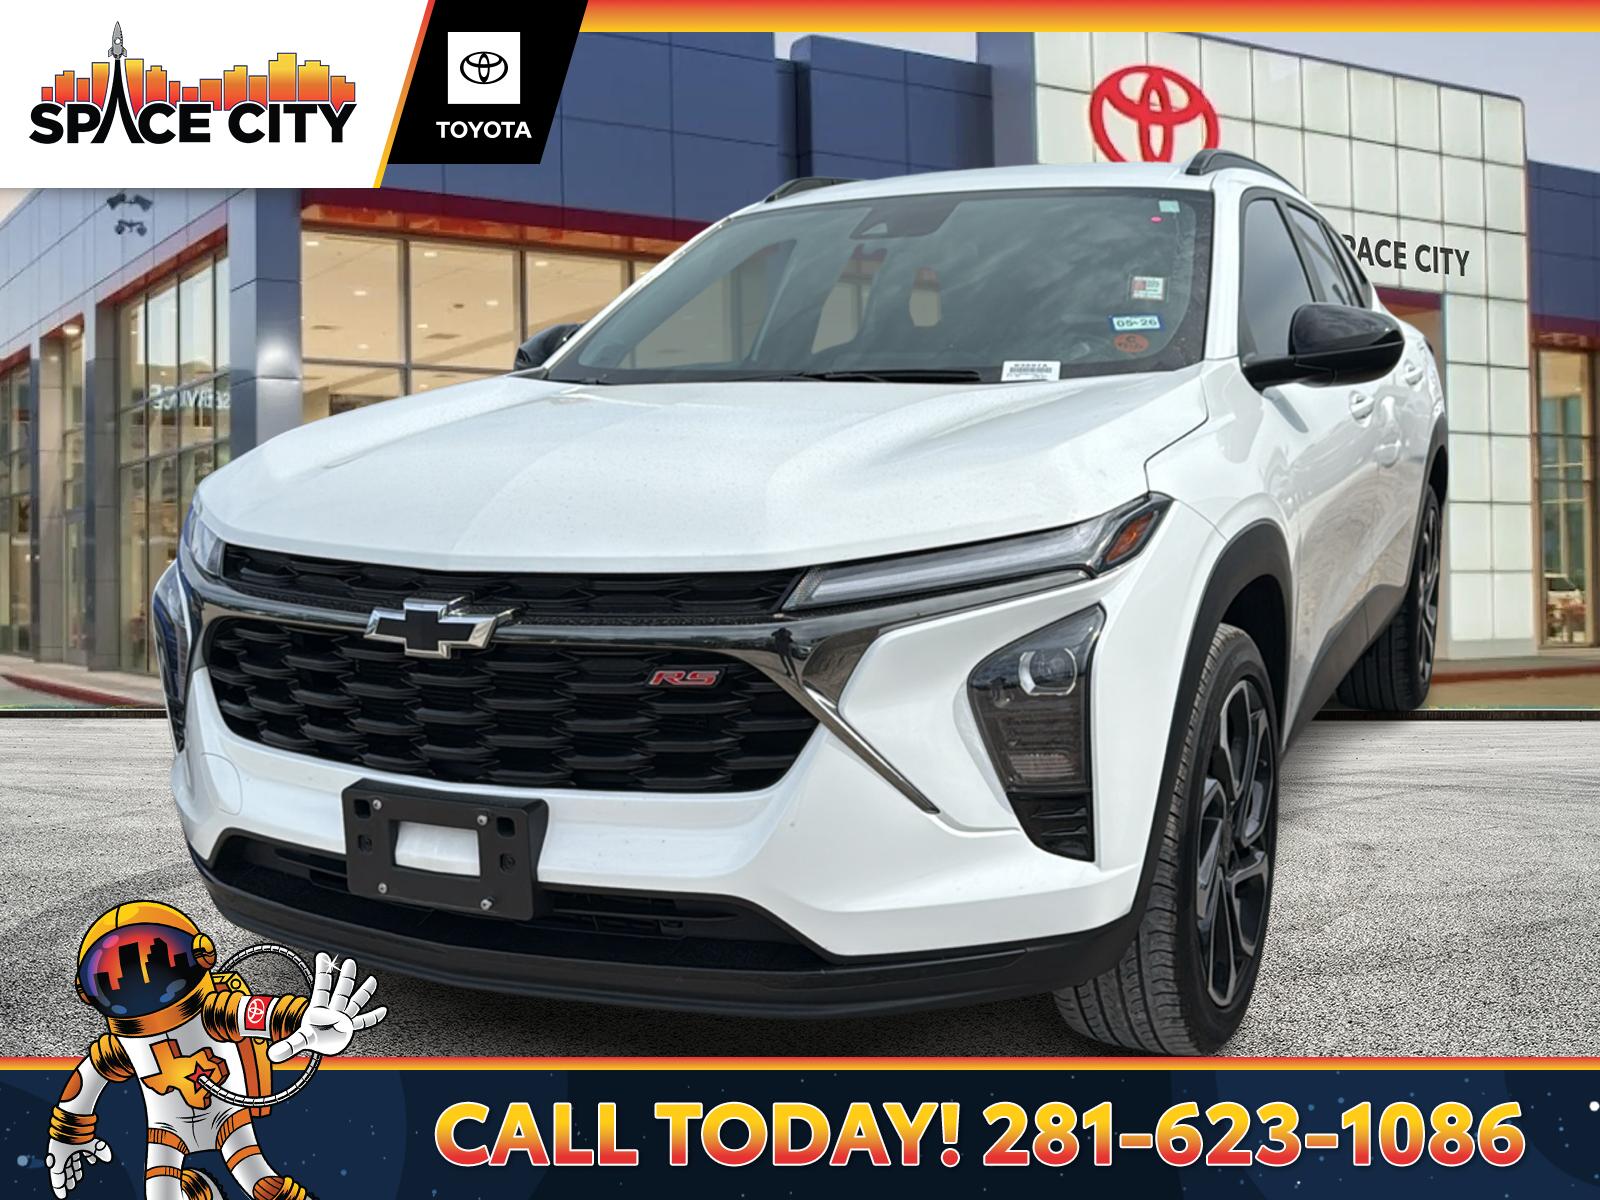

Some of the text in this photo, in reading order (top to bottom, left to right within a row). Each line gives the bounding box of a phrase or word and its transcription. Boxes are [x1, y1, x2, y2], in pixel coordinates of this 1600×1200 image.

[1341, 234, 1470, 276] PACE CITY
[649, 670, 720, 686] RS
